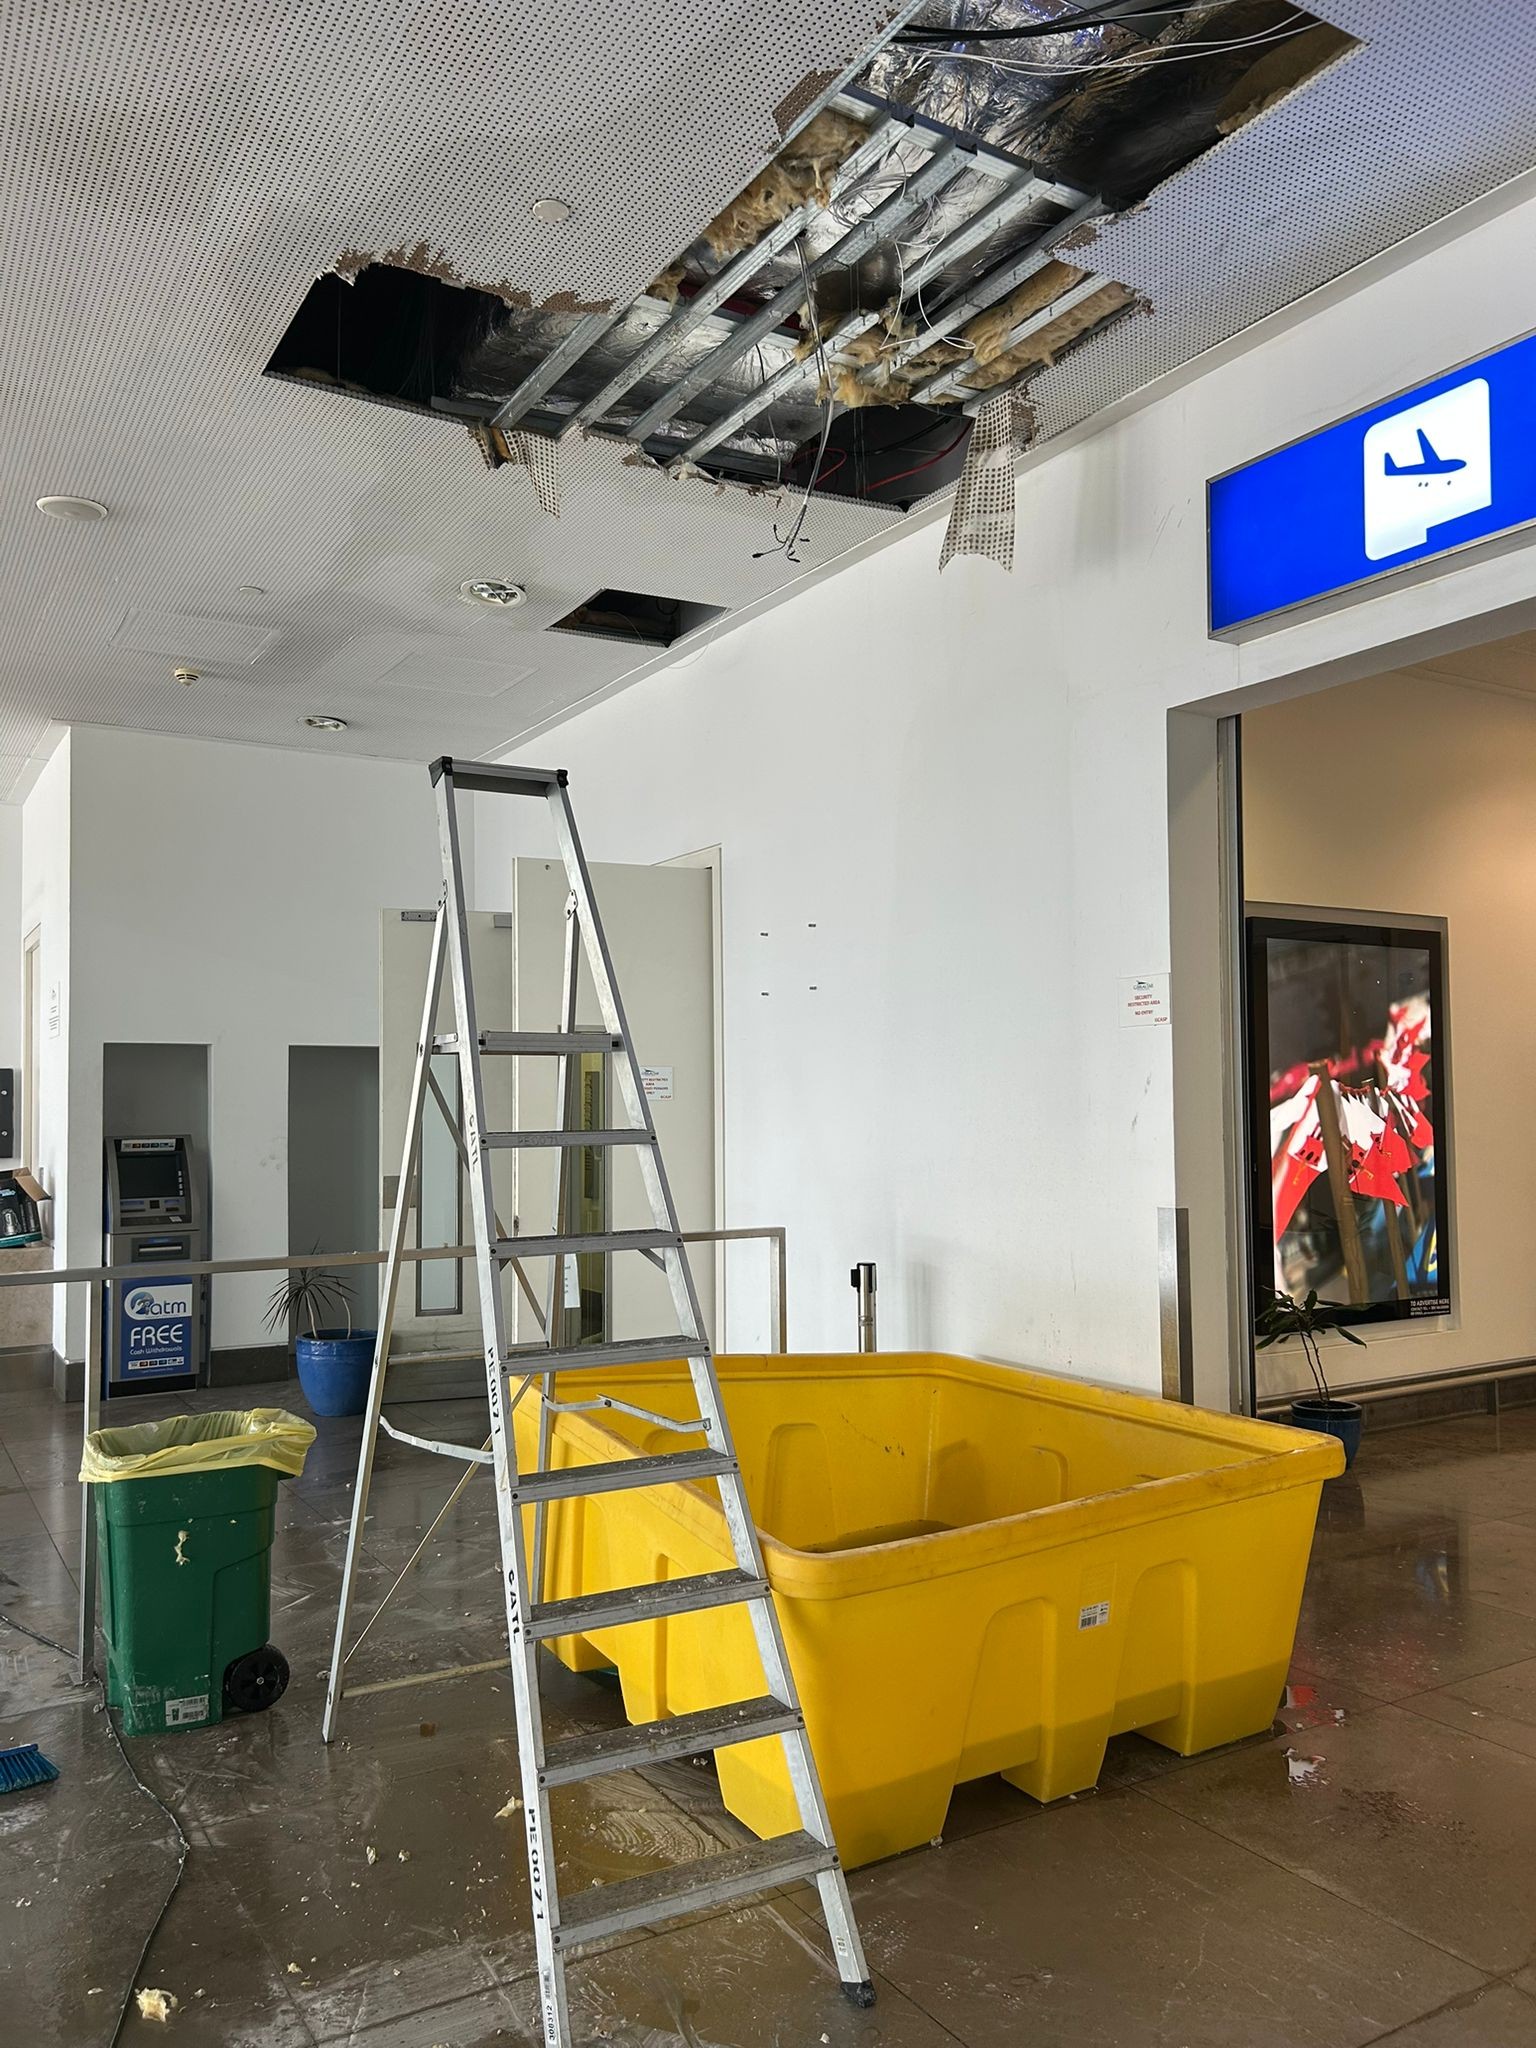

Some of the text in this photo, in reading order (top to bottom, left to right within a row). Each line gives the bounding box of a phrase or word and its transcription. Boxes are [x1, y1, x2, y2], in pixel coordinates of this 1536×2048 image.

[130, 1324, 183, 1347] FREE
[130, 1345, 183, 1356] Cash Withdrawals
[528, 1808, 544, 1920] PE0071
